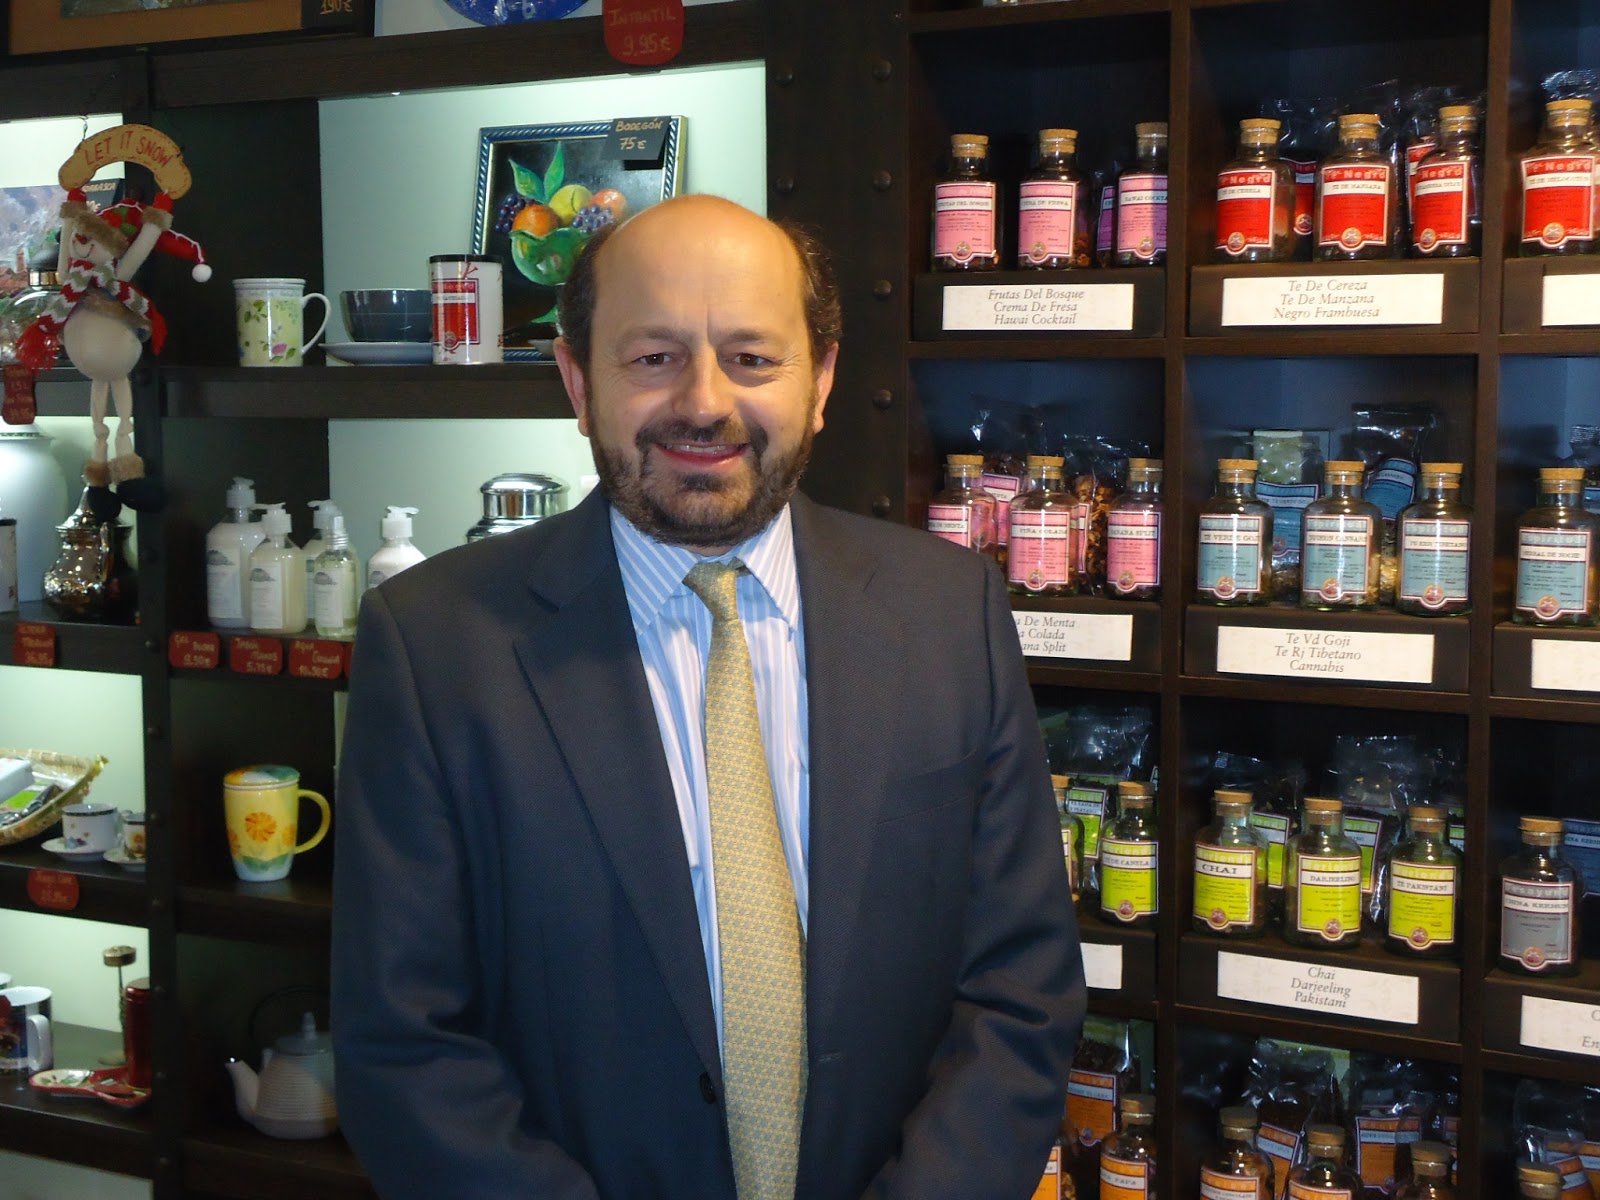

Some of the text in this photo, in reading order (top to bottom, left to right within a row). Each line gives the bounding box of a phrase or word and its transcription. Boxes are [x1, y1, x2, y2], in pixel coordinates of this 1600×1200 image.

[84, 130, 174, 168] LET IT SNOW
[1230, 173, 1271, 184] Negro
[1343, 168, 1386, 180] Negro
[1288, 279, 1368, 291] Te De Cereza
[987, 288, 1085, 301] Frutas Del Bosque
[1280, 294, 1374, 305] Te De Manzana
[993, 302, 1077, 312] Crema De Fresa
[994, 313, 1077, 325] Hawai Cocktail
[1273, 307, 1381, 321] Negro Frambuesa
[1024, 615, 1040, 627] De
[1042, 616, 1076, 628] Menta
[1028, 628, 1065, 640] Colada
[1285, 633, 1352, 648] Te Vd Goji
[1042, 641, 1067, 654] Split
[1274, 646, 1289, 657] Te
[1309, 648, 1362, 660] Tibetano
[1289, 660, 1345, 673] Cannabis
[1201, 863, 1238, 875] CHAI
[1406, 882, 1448, 892] PAKISTANI
[1307, 966, 1336, 981] Chai
[1291, 977, 1352, 999] Darjeeling
[1294, 991, 1347, 1009] Pakistani
